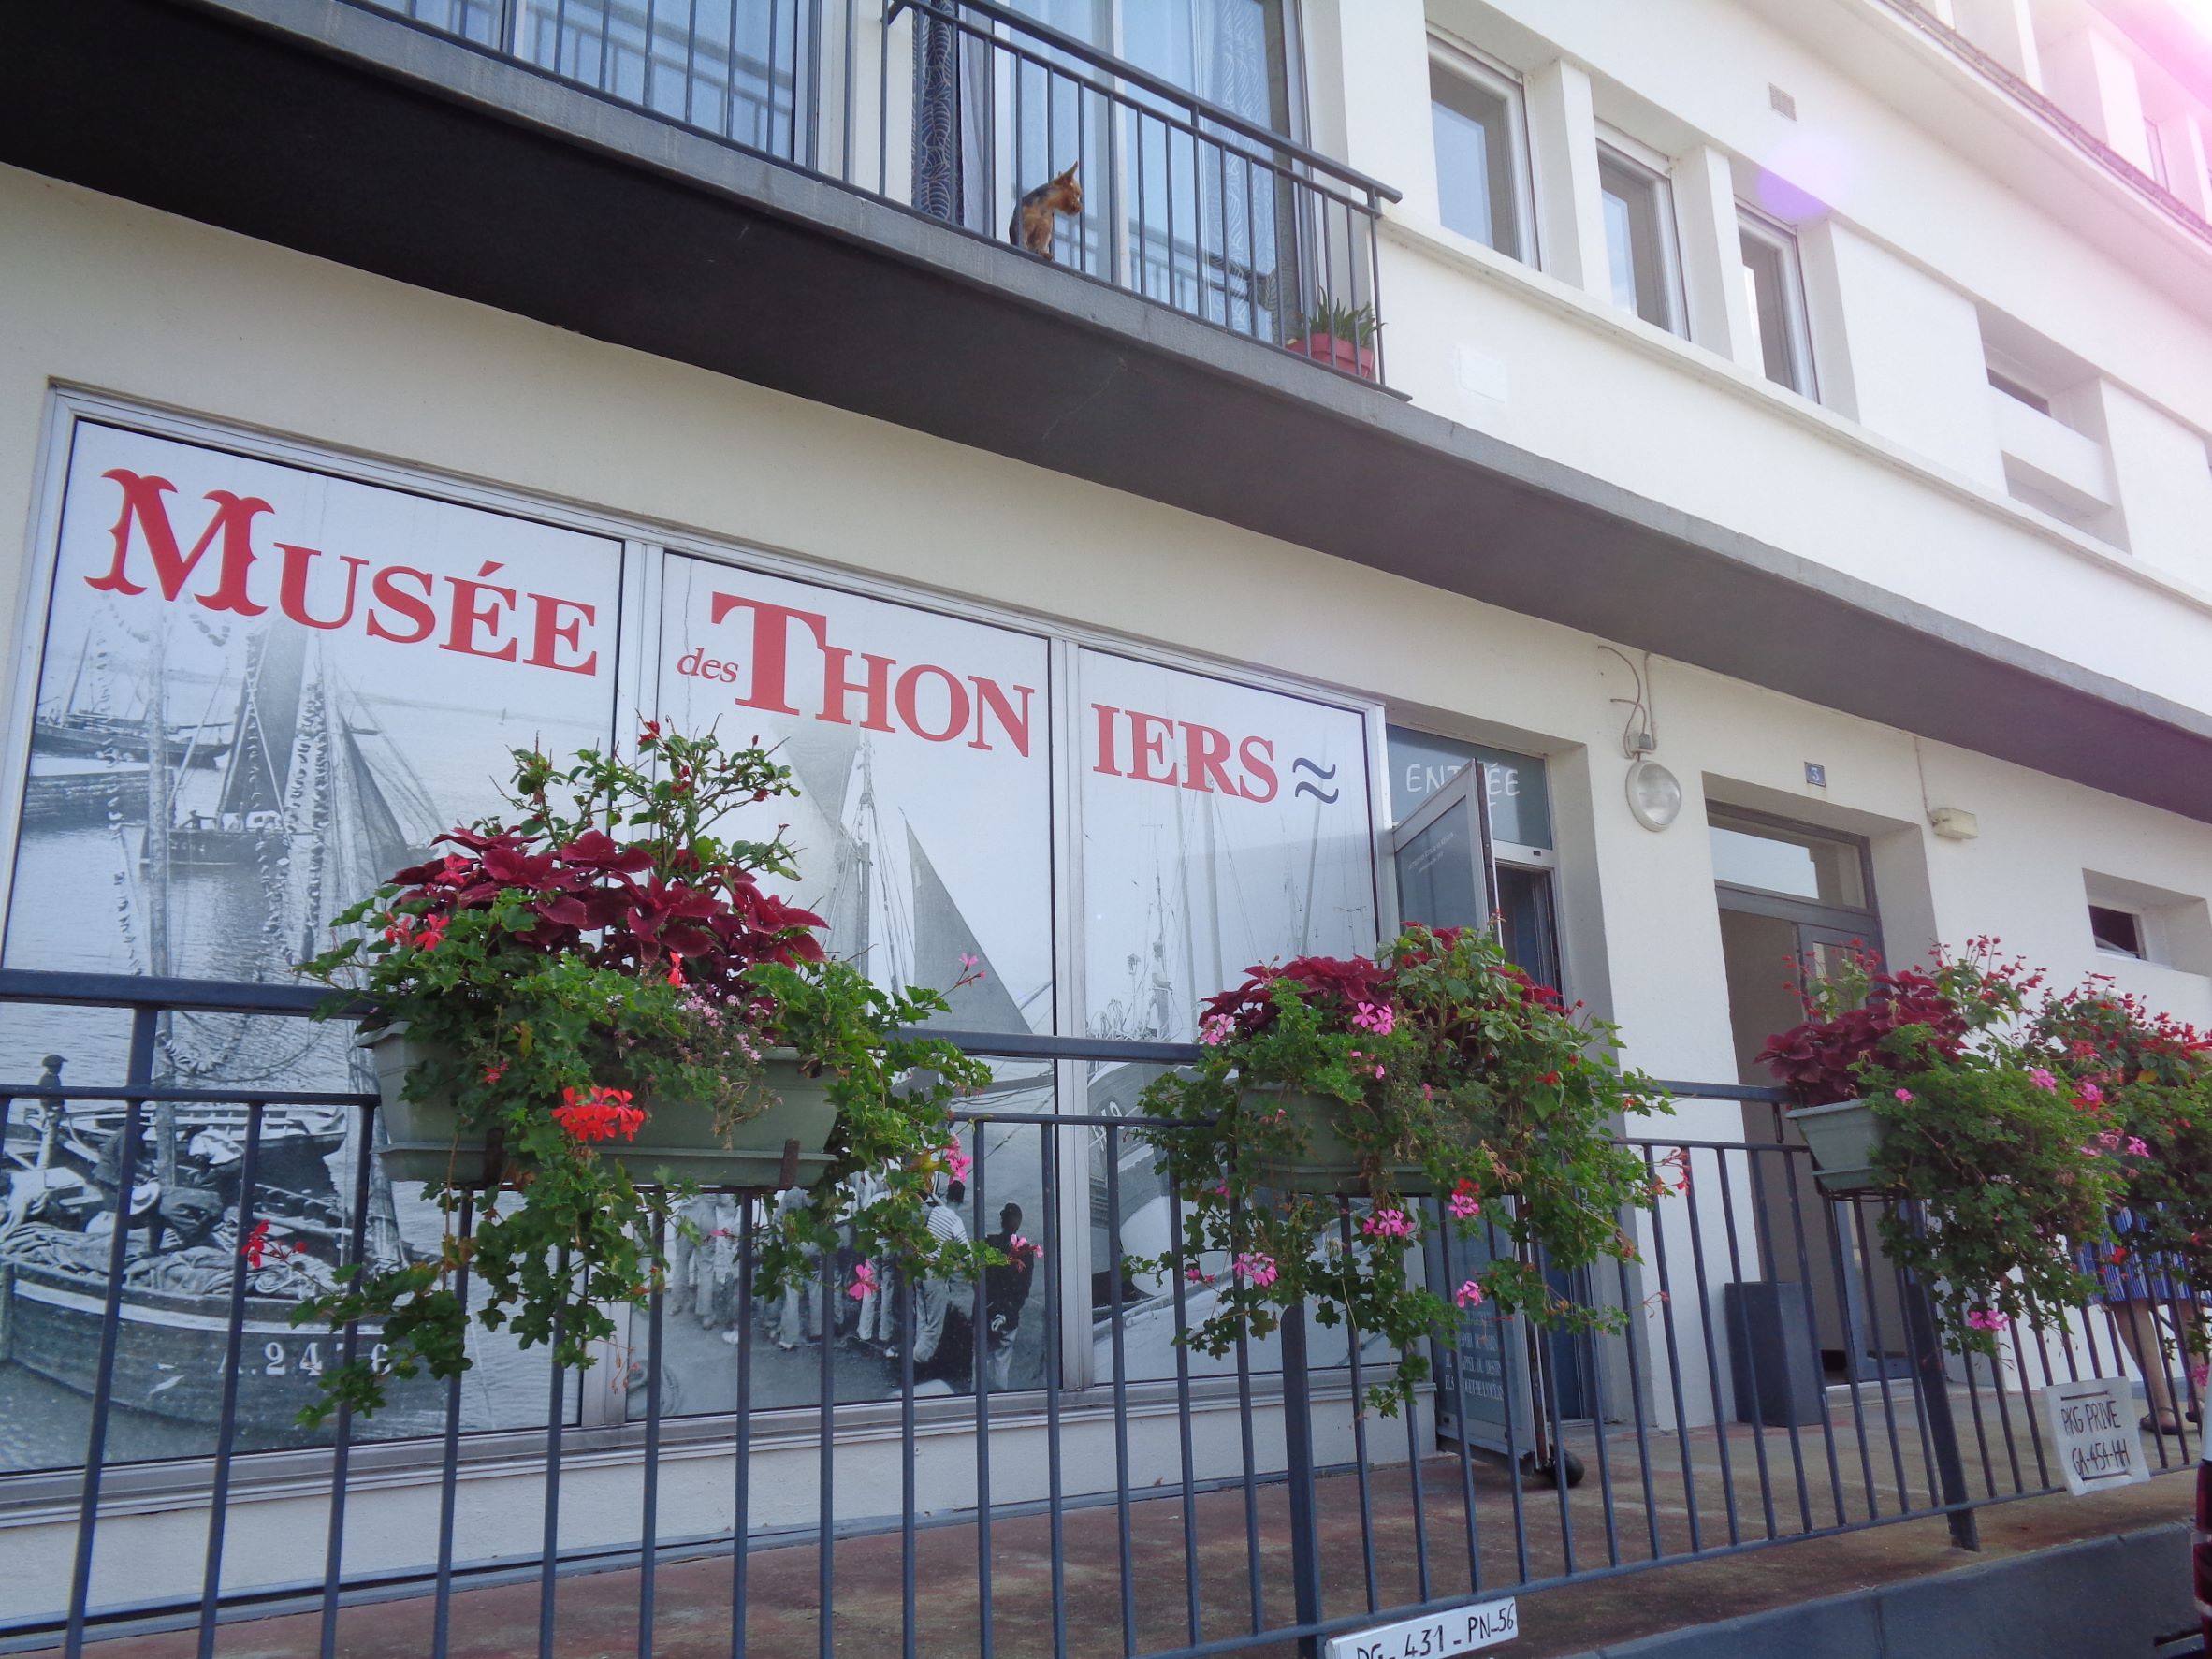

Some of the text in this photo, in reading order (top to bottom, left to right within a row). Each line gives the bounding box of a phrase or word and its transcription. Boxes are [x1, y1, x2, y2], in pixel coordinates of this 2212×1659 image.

[84, 468, 597, 676] MUSÉE
[677, 647, 739, 684] des
[1091, 703, 1279, 804] IERS
[1406, 763, 1521, 796] ENÉE
[2061, 1406, 2084, 1436] PKG
